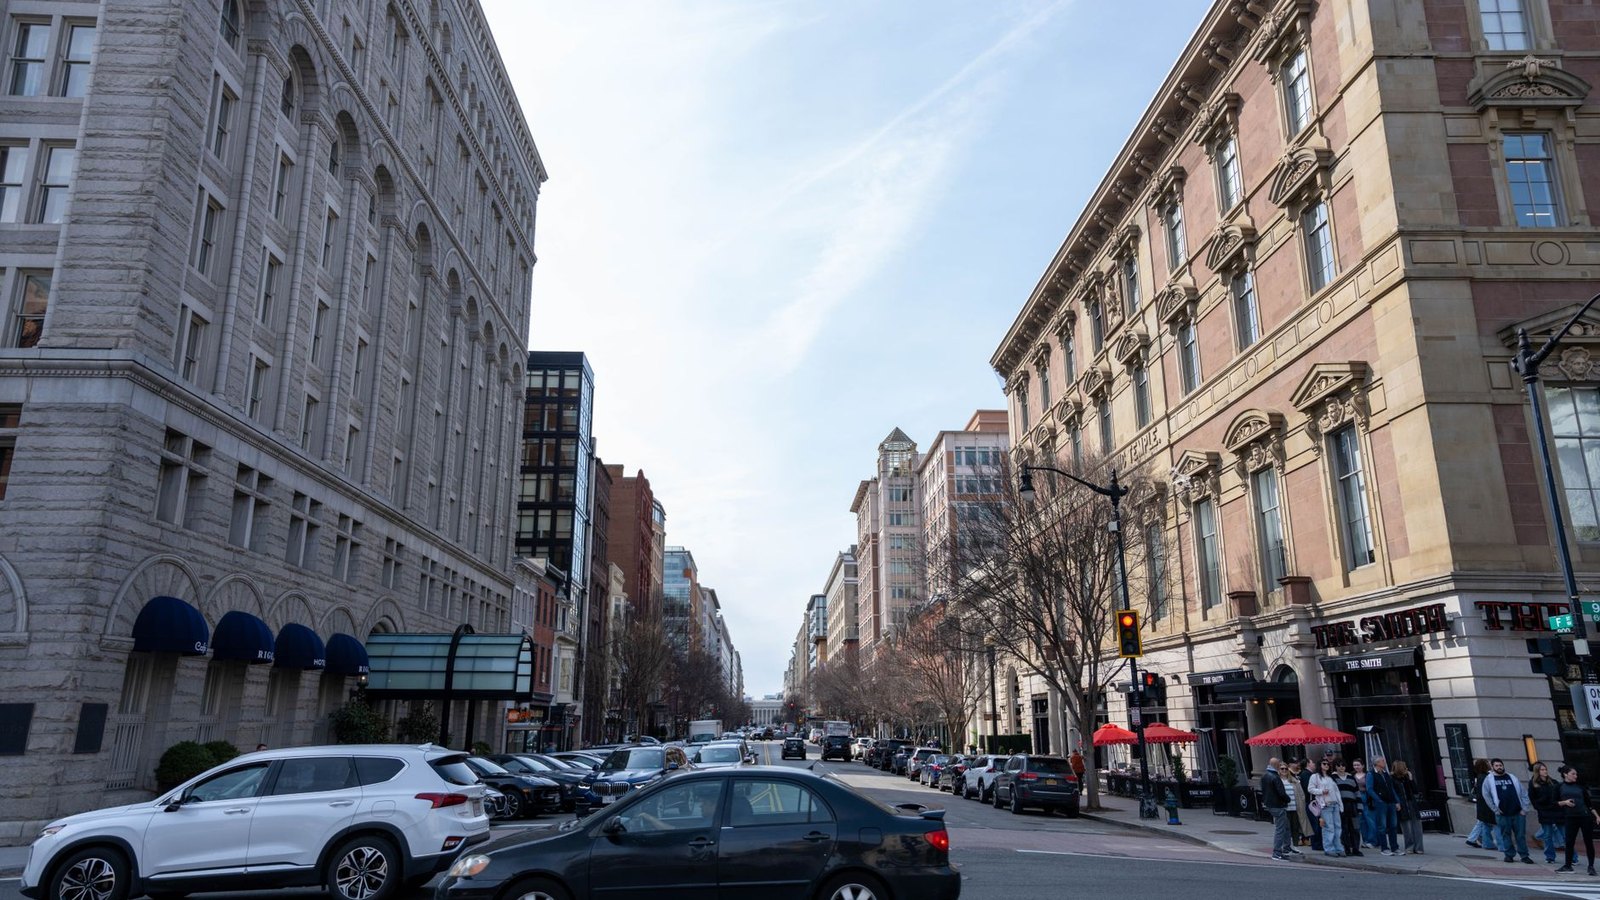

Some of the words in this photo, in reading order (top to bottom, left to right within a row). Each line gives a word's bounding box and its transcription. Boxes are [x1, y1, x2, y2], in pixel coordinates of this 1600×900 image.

[1310, 621, 1359, 649] THE
[1360, 603, 1450, 643] SMITH
[1346, 660, 1359, 670] THE
[1360, 658, 1382, 668] SMITH
